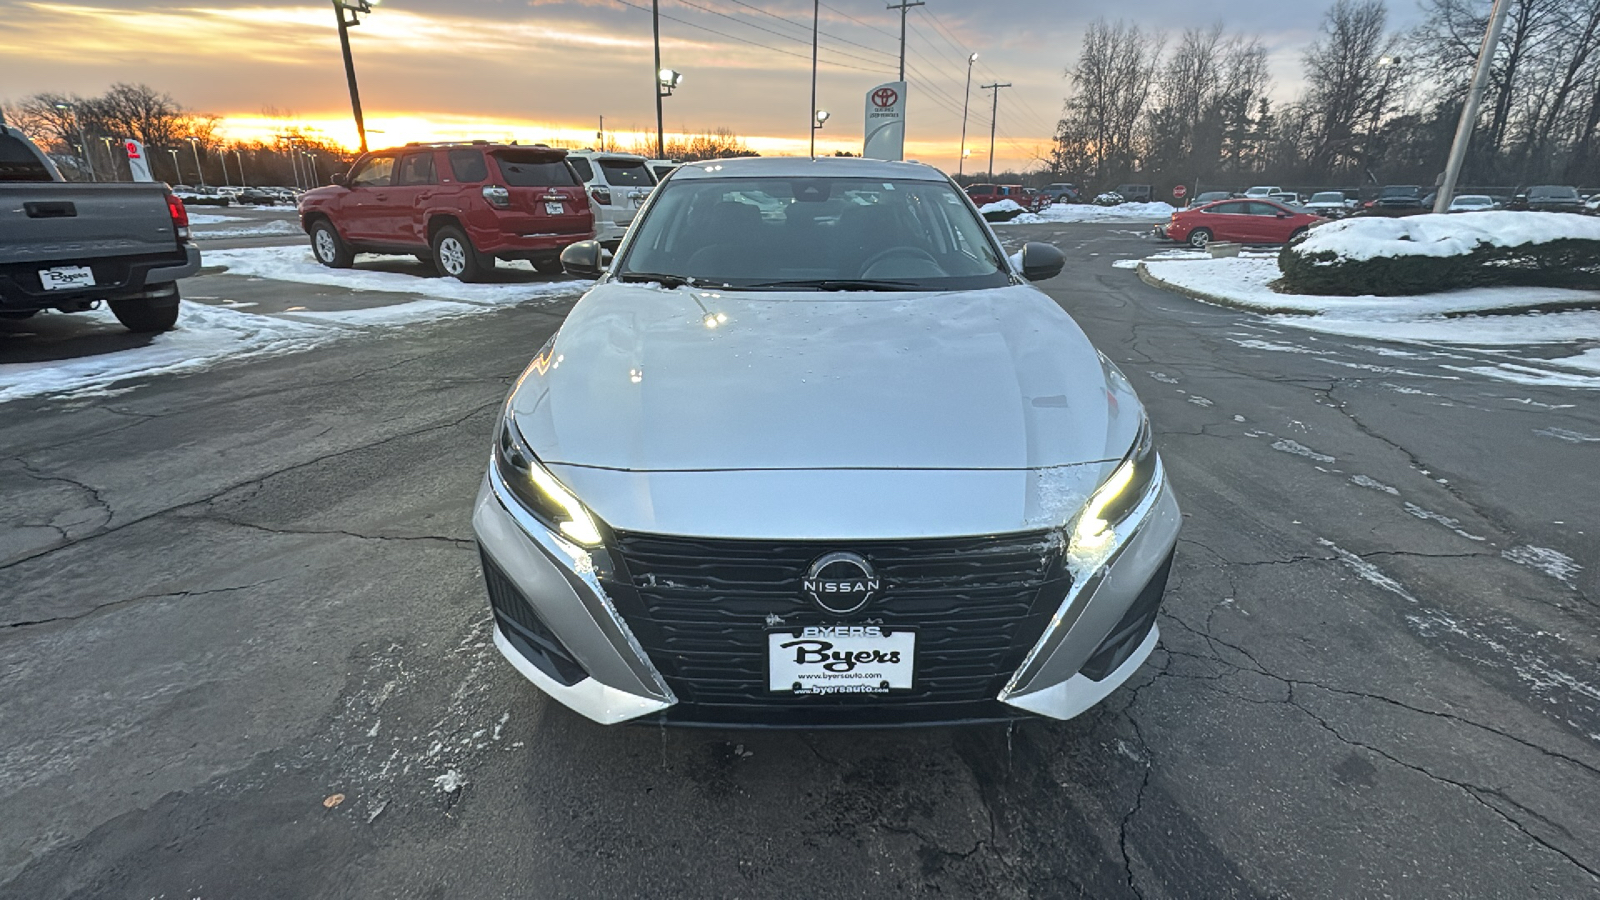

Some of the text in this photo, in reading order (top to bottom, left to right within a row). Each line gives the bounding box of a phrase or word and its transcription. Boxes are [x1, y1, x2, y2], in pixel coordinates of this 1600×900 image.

[803, 579, 880, 593] NISSAN
[803, 626, 882, 639] BYERS
[779, 639, 901, 673] Byers
[797, 672, 883, 680] www.byersauto.com
[794, 684, 889, 696] www.byersauto.com
